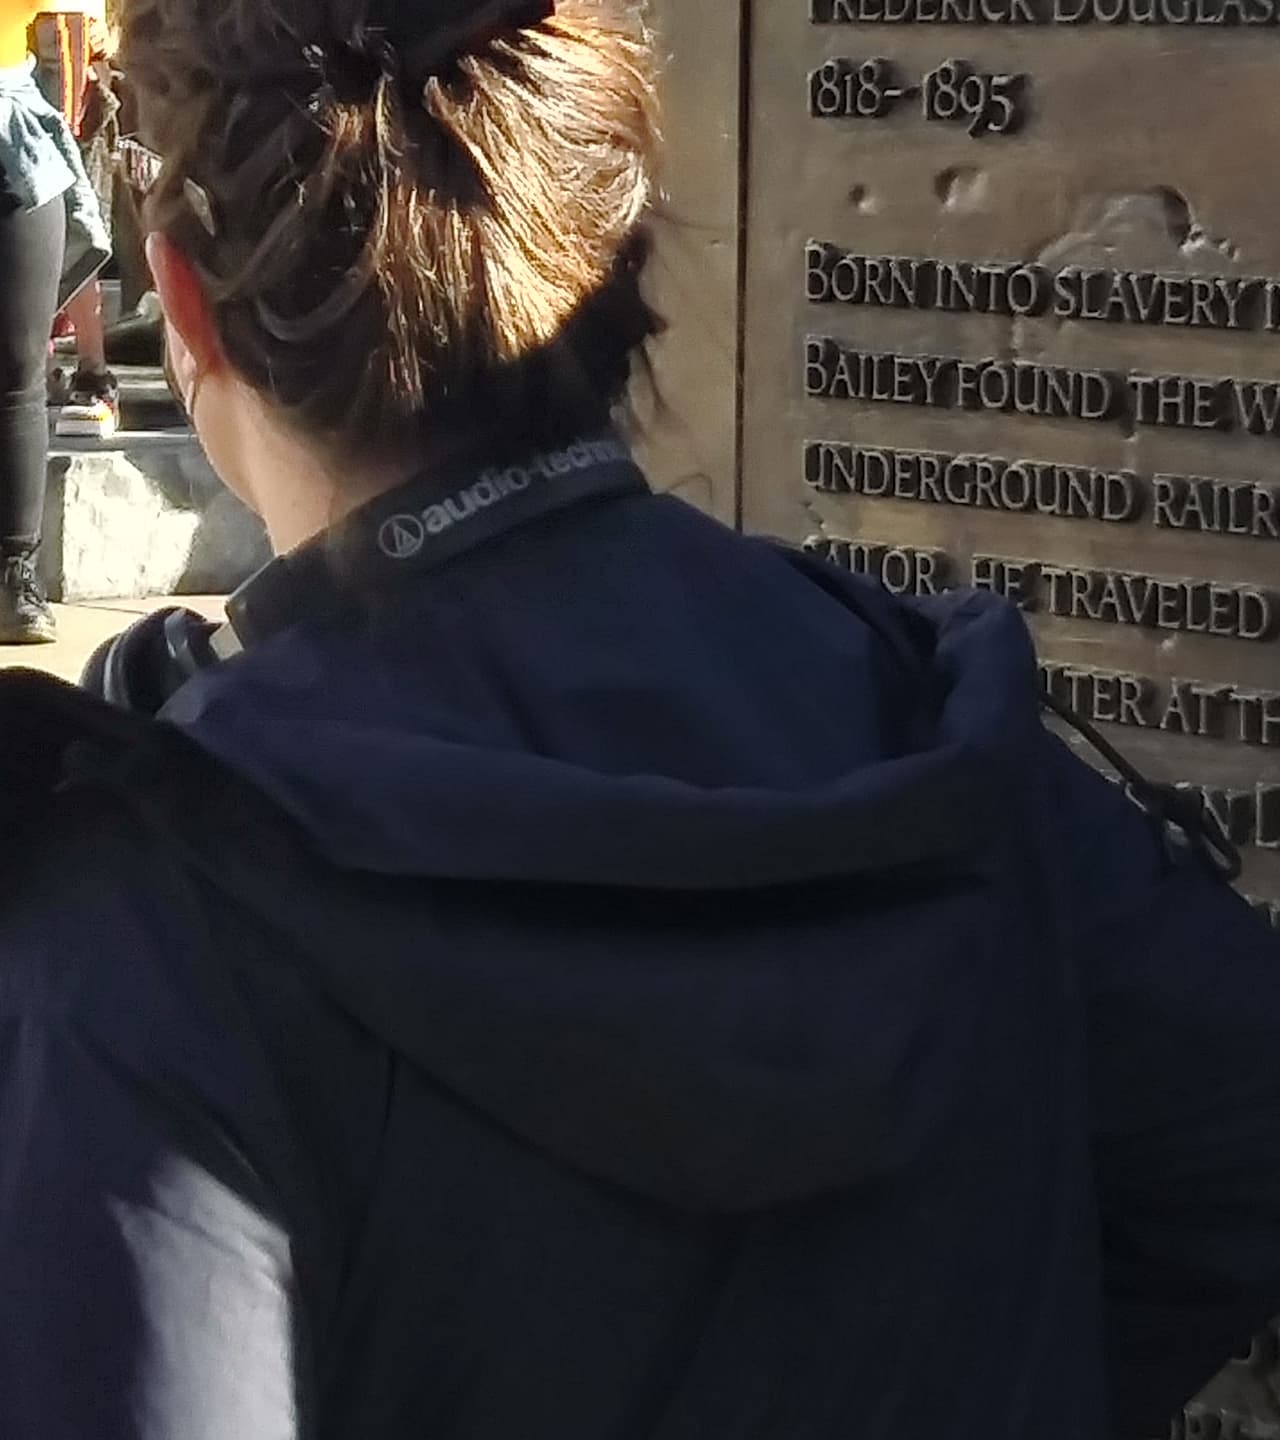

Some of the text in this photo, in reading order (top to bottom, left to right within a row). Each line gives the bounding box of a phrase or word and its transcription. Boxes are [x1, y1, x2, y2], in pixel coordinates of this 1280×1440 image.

[804, 241, 917, 306] BORN
[934, 260, 1040, 317] INTO
[1052, 266, 1246, 329] SLAVERY
[804, 336, 942, 406] BAILEY
[956, 357, 1112, 421] FOUND
[1130, 370, 1218, 428] THE
[804, 441, 1135, 522] UNDERGROUND
[970, 554, 1025, 607] HE
[1040, 565, 1272, 641] TRAVELED
[1158, 678, 1220, 736] AT
